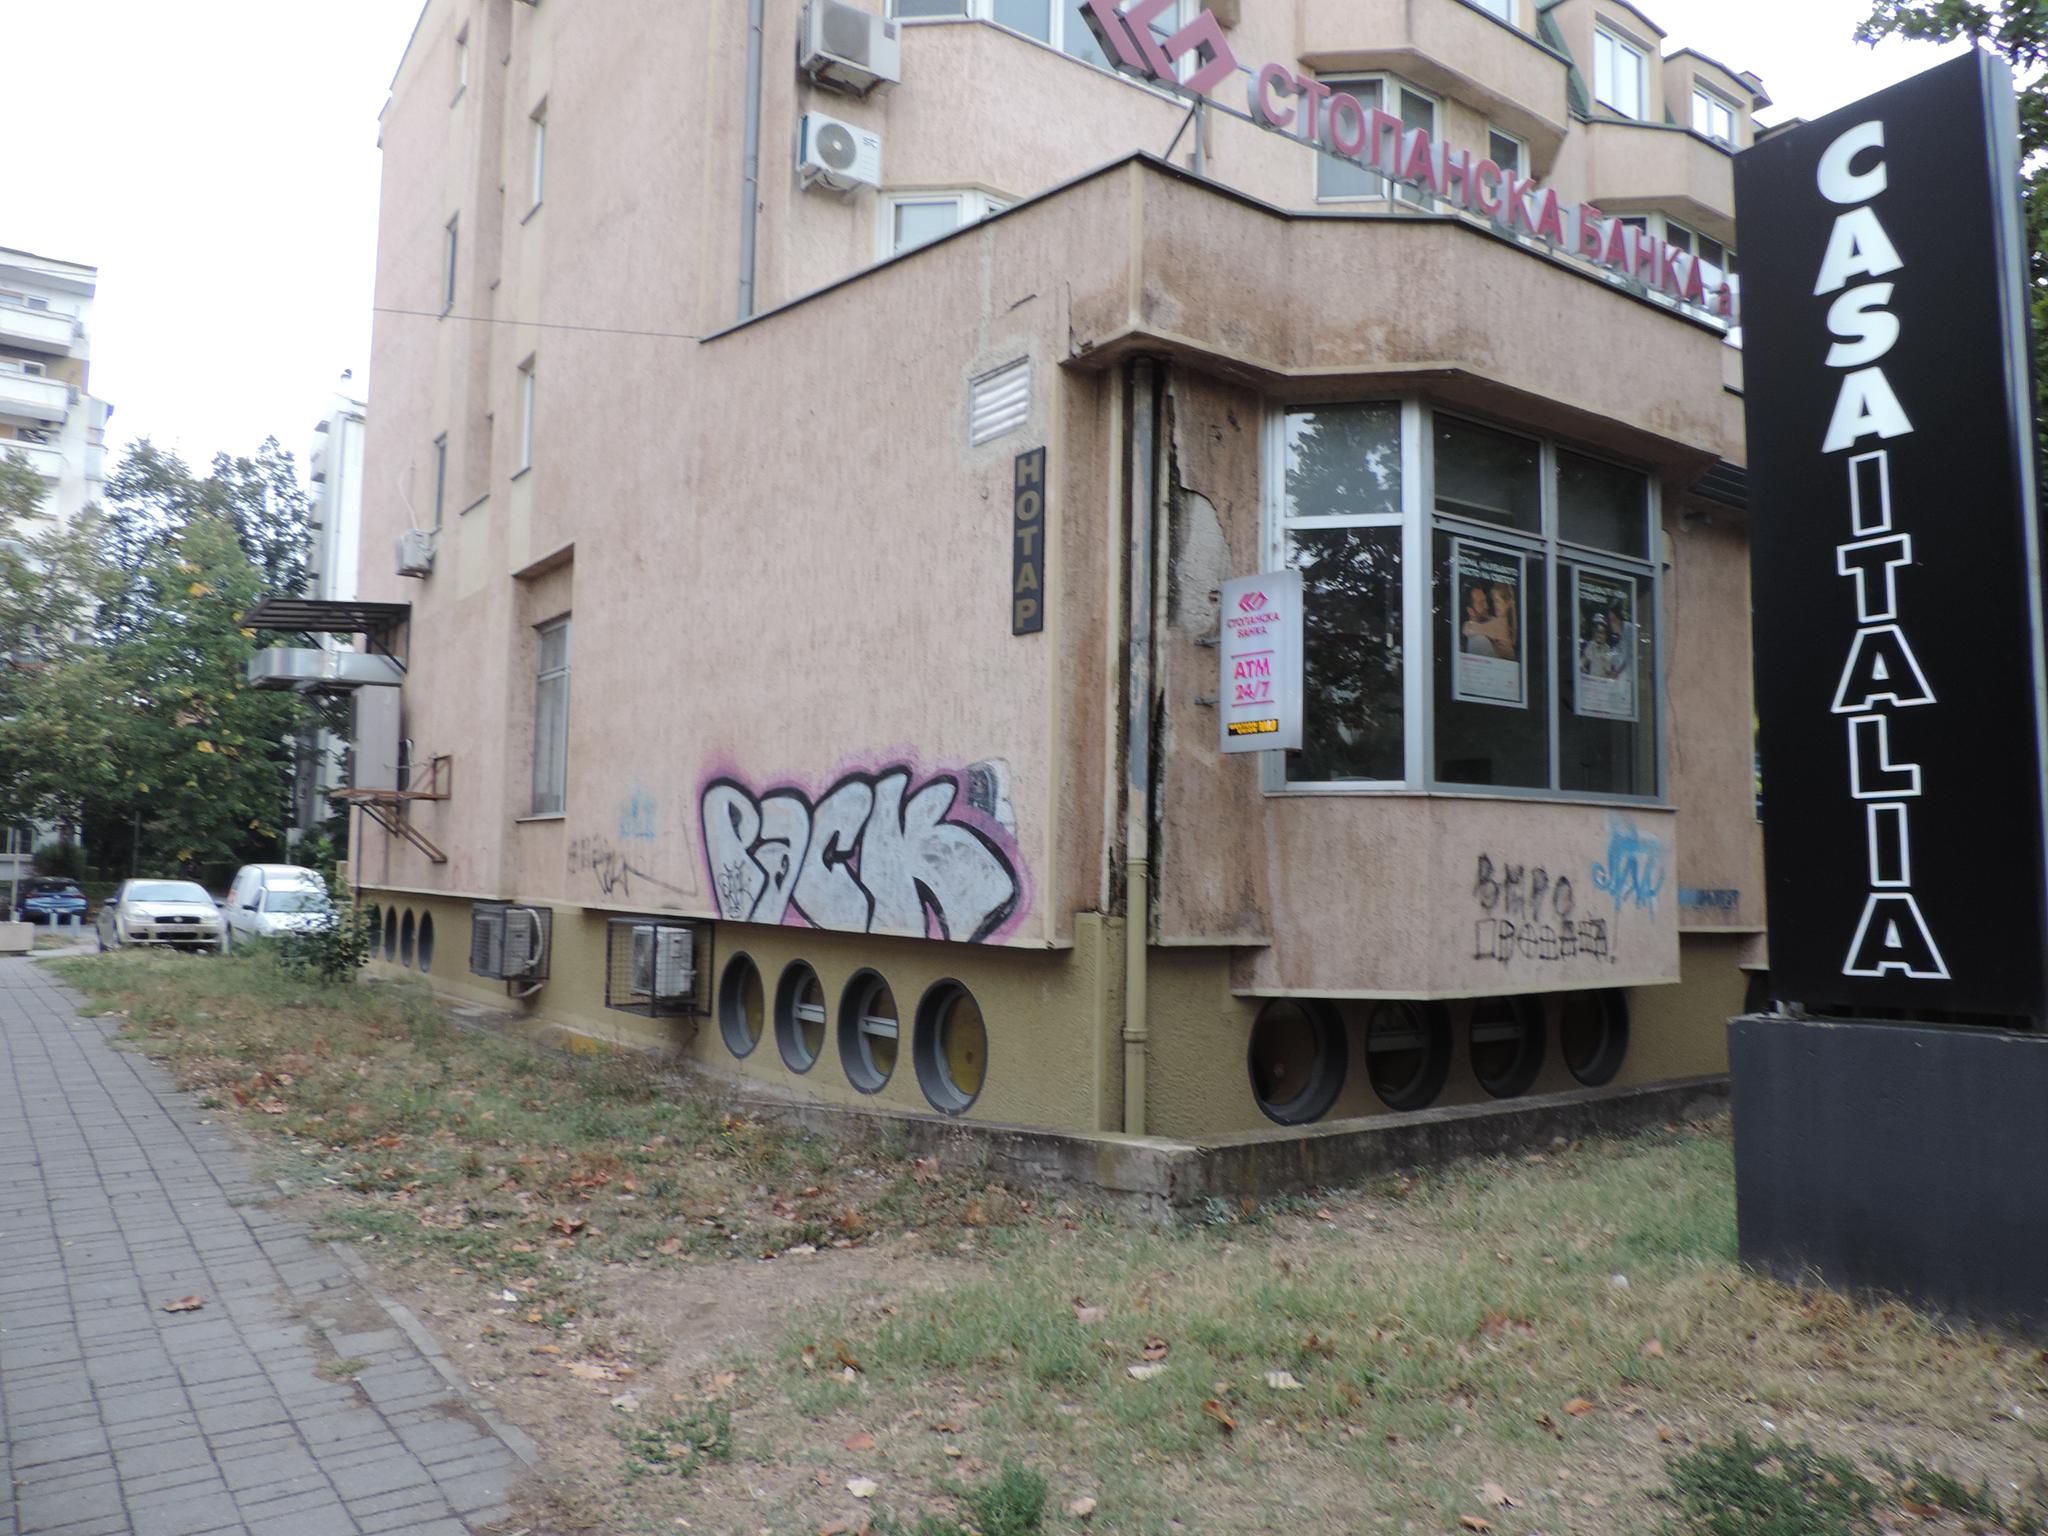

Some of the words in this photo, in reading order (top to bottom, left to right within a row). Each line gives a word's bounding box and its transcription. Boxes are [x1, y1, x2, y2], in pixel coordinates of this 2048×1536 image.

[1251, 62, 1564, 246] СТОПАНСКА
[1578, 203, 1707, 306] БАНКА
[1813, 120, 1914, 454] CASA
[1015, 454, 1041, 629] НОТАР
[1235, 681, 1271, 700] 24/7
[1831, 449, 1951, 980] ITALIA
